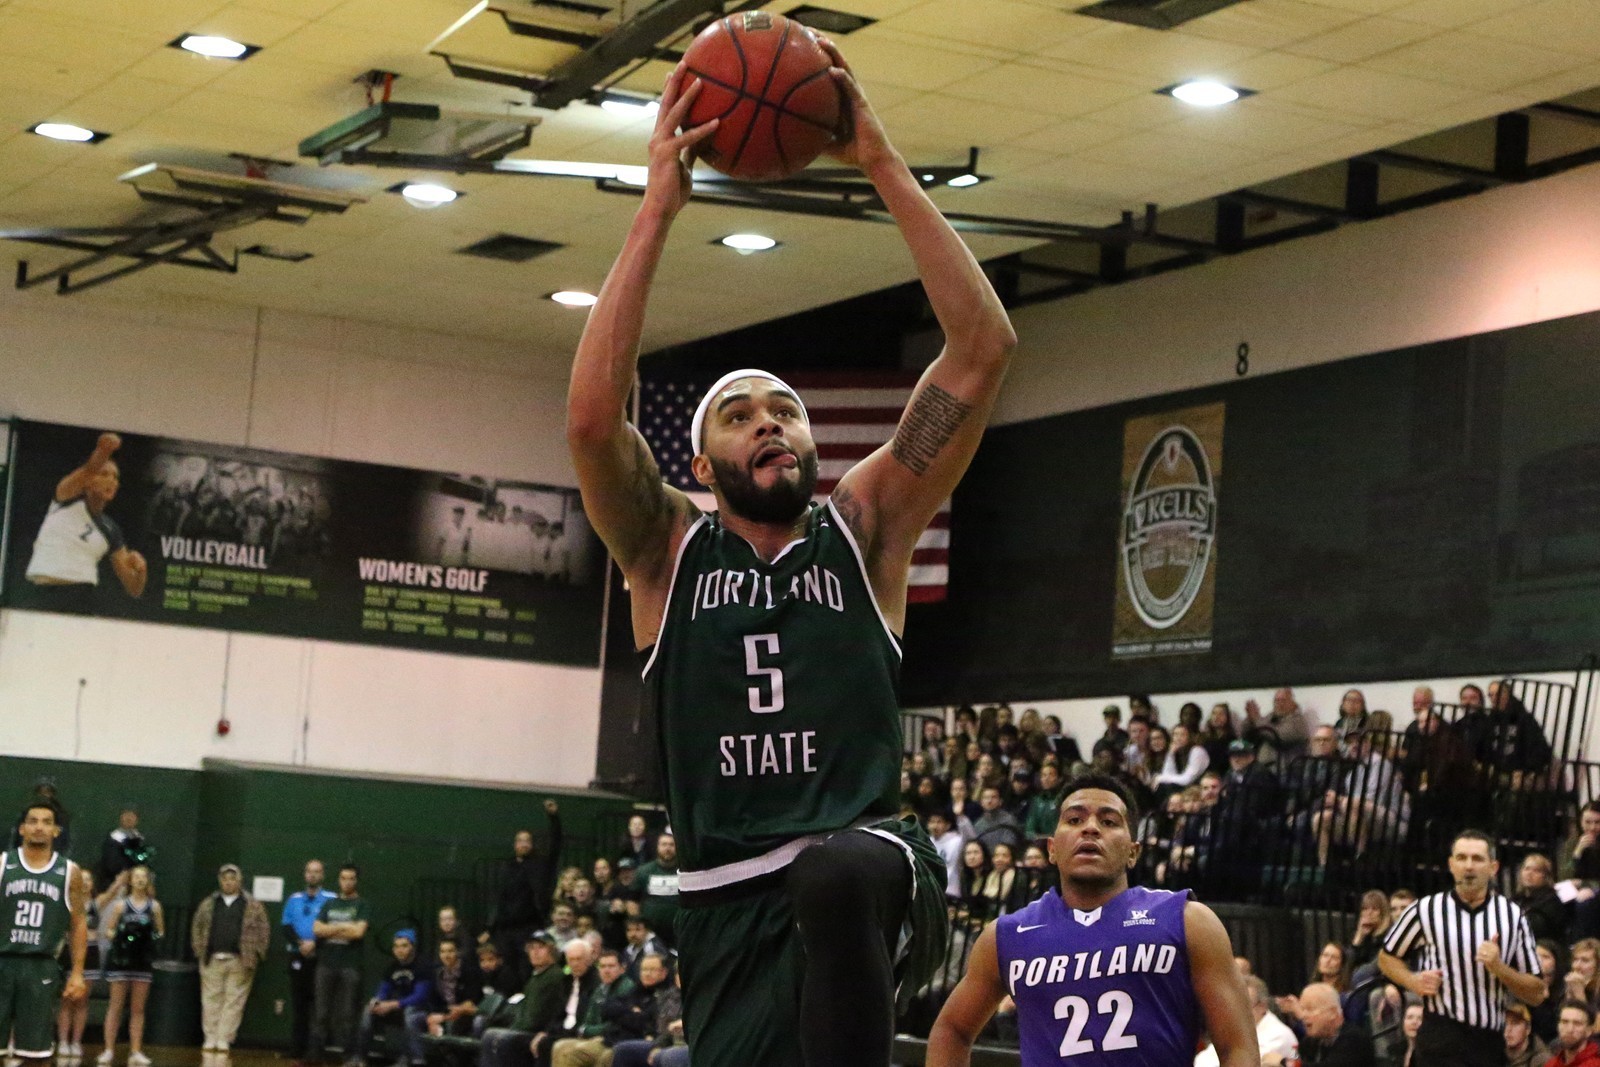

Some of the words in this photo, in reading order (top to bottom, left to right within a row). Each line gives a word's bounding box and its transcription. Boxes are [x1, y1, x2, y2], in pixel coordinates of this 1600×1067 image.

[1236, 343, 1249, 376] 8
[1149, 490, 1207, 521] KELLS
[161, 535, 268, 569] VOLLEYBALL
[359, 557, 444, 588] WOMEN'S
[445, 568, 489, 593] GOLF
[743, 633, 785, 714] 5
[719, 731, 817, 777] STATE
[5, 878, 60, 901] PORTLAND
[15, 900, 44, 927] 20
[10, 929, 40, 945] STATE
[1009, 943, 1177, 996] PORTLAND
[1053, 990, 1138, 1057] 22
